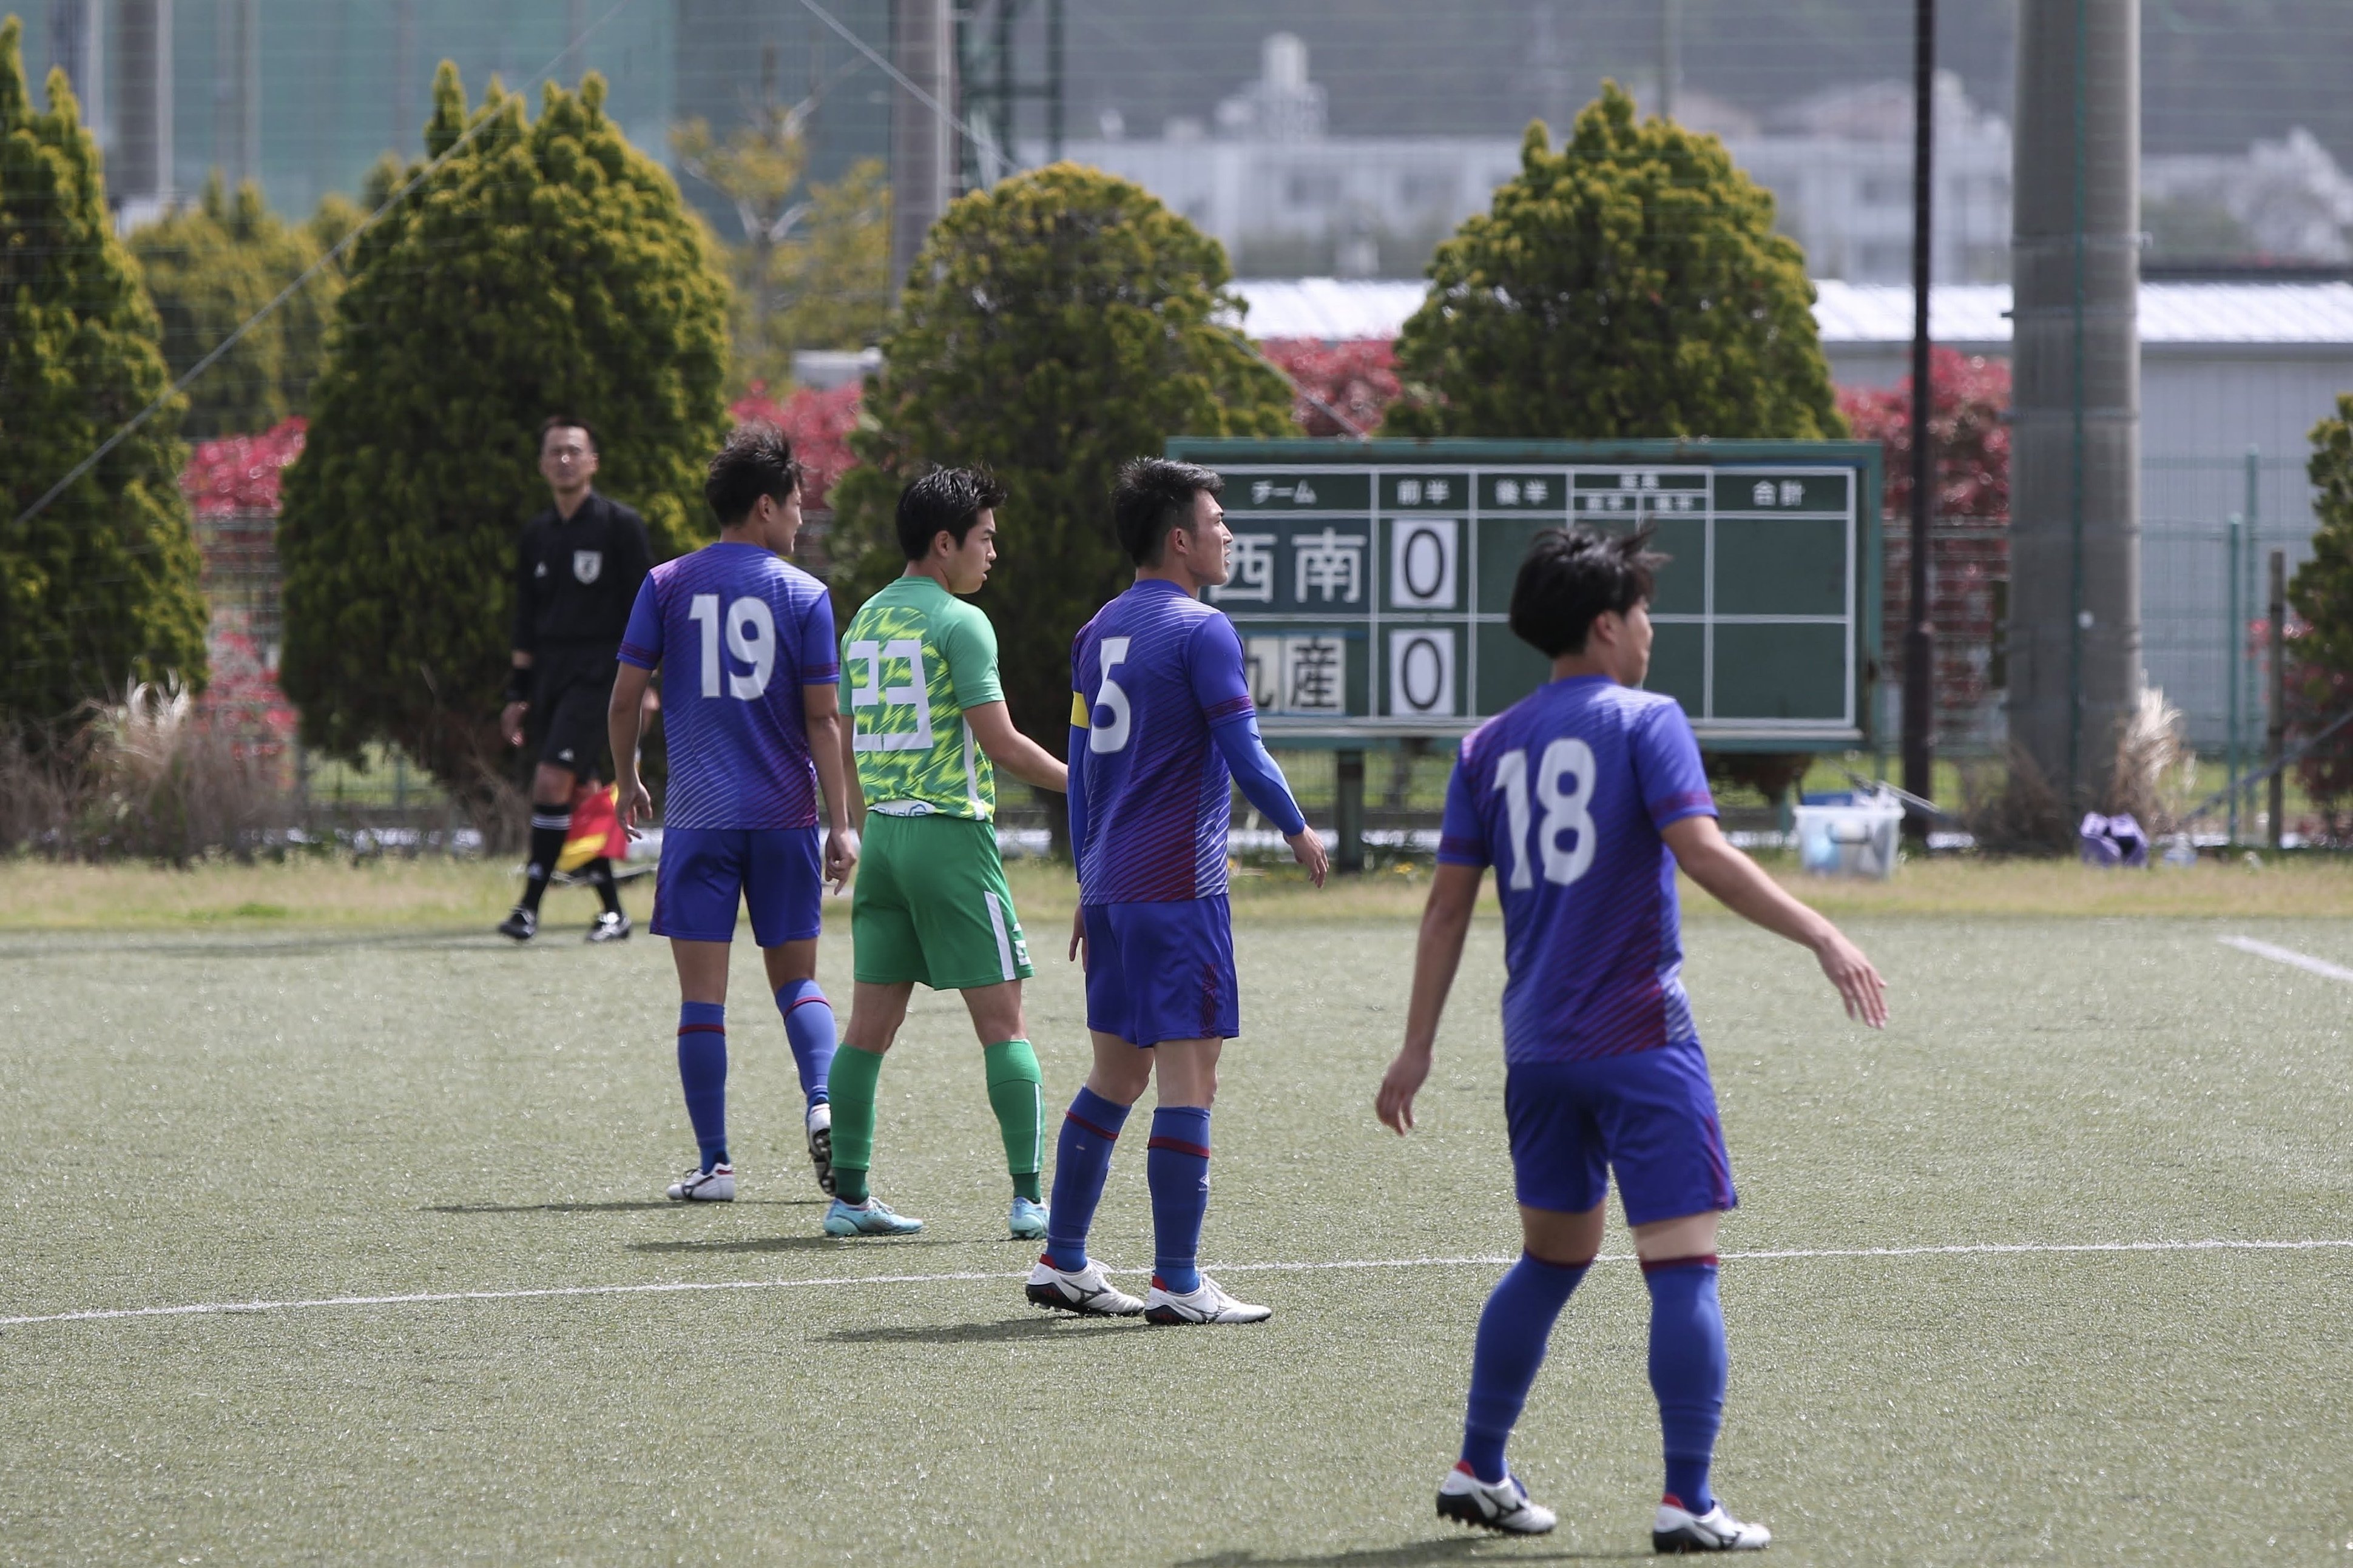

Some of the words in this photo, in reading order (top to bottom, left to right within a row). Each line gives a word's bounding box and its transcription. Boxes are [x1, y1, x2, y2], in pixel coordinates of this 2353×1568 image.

[1251, 479, 1317, 505] チーム
[1397, 479, 1450, 505] 前半
[1754, 480, 1804, 506] 合計
[1208, 527, 1368, 604] 西南
[1405, 528, 1445, 599] 0
[688, 593, 777, 701] 19
[1402, 638, 1442, 710] 0
[1090, 636, 1131, 754] 5
[1493, 738, 1596, 892] 18
